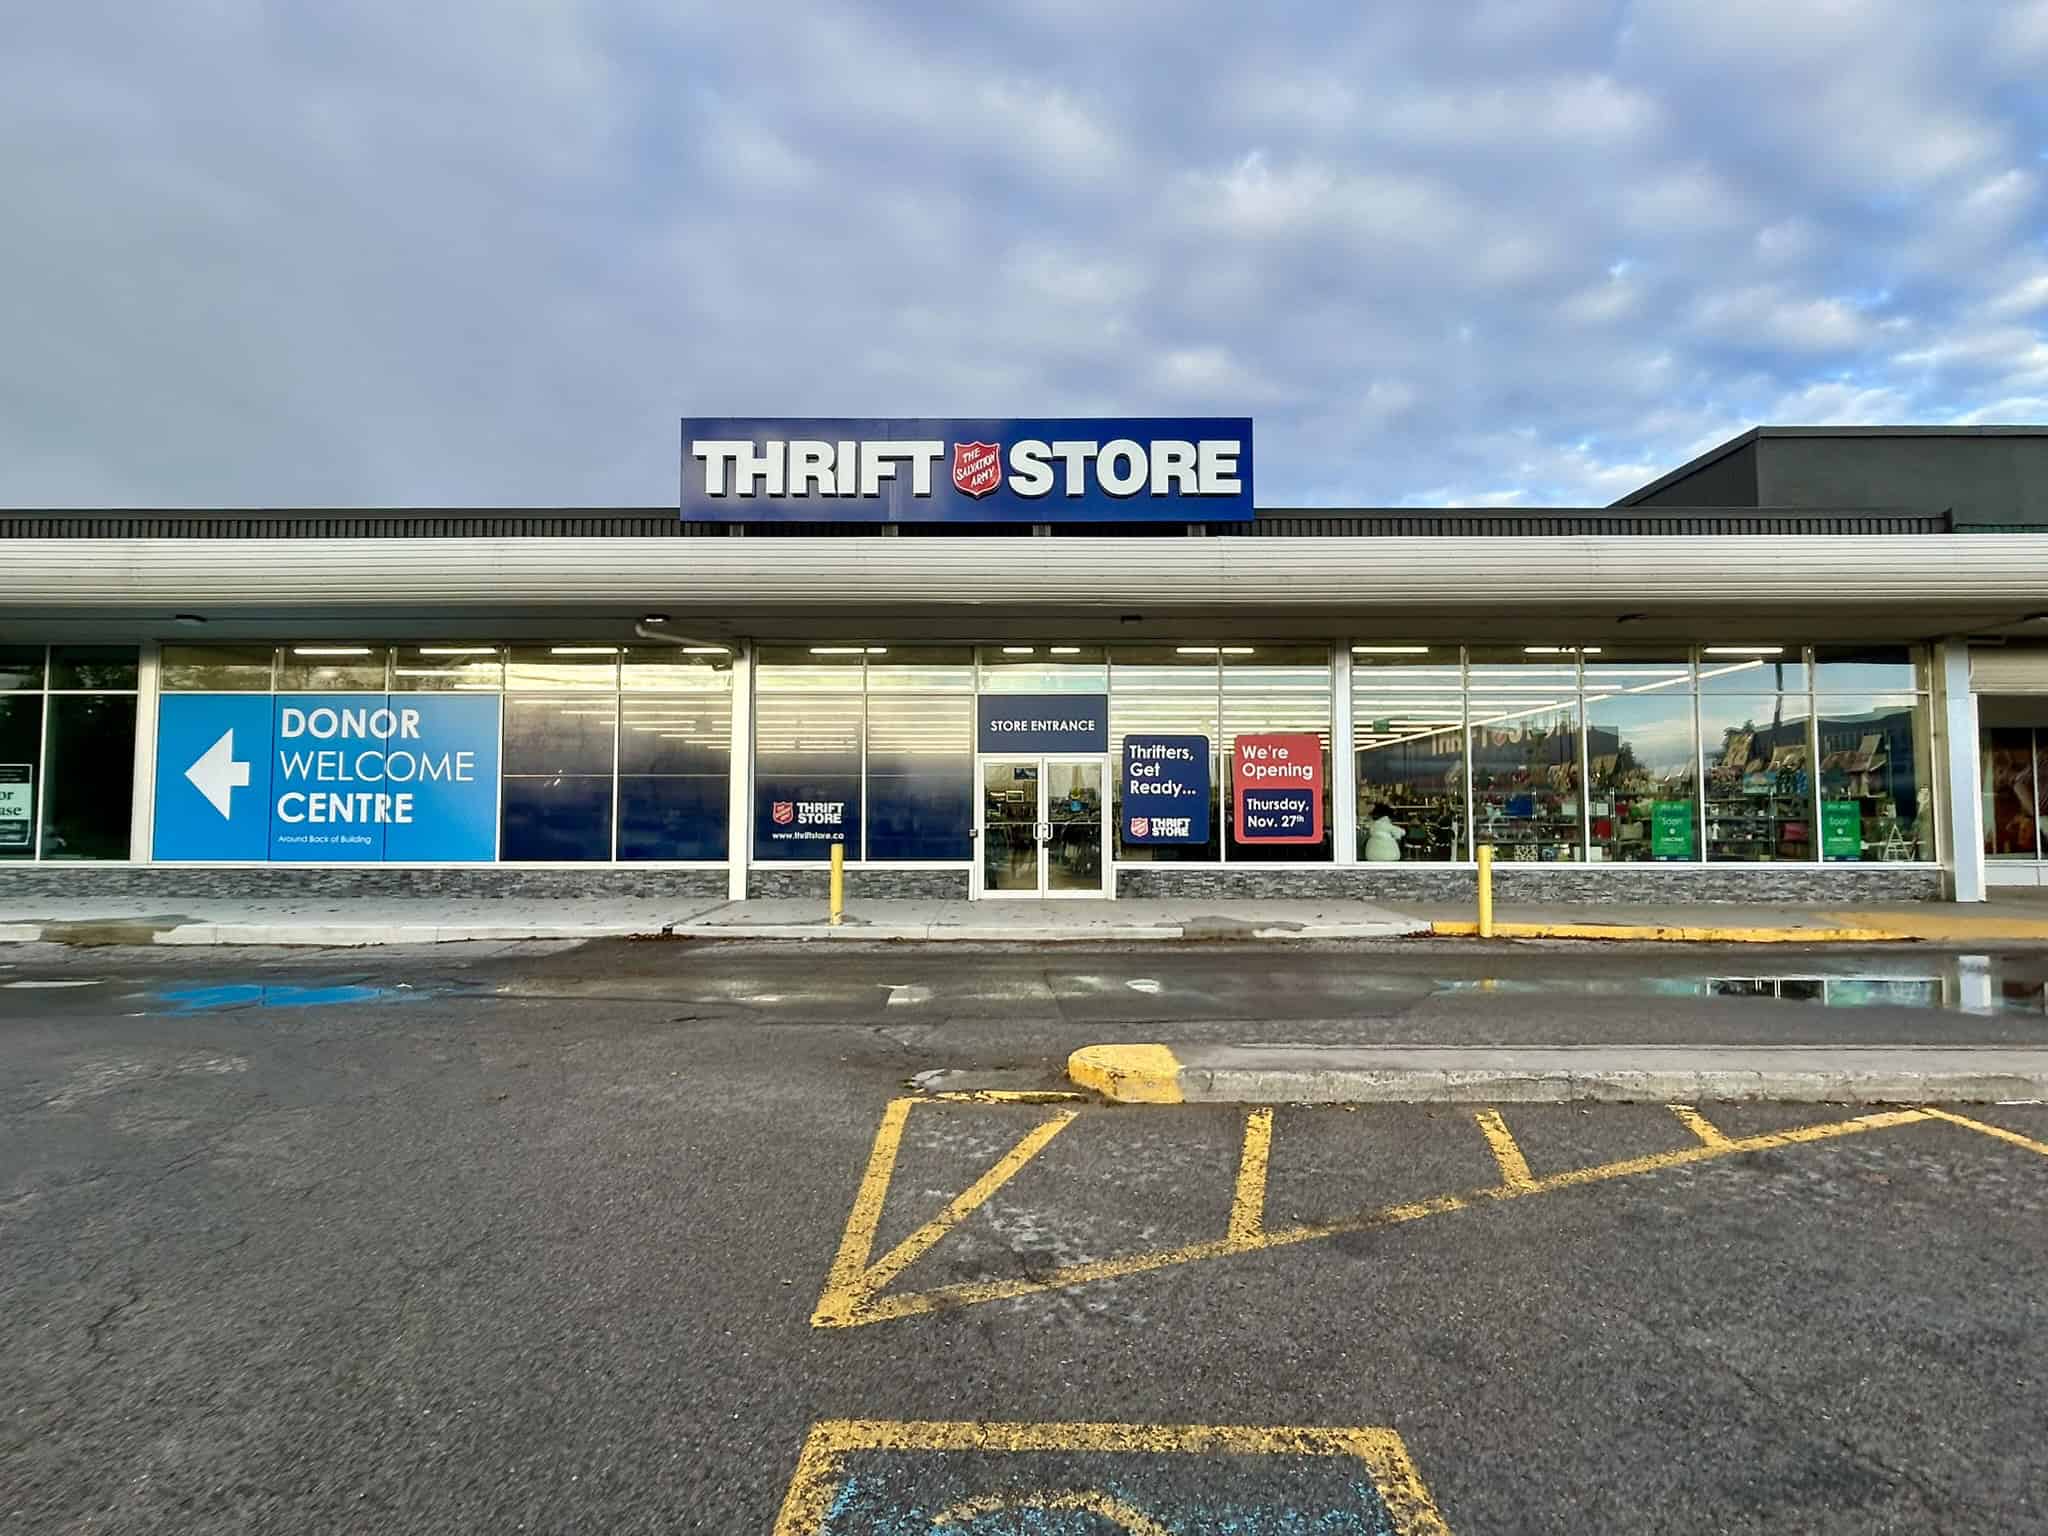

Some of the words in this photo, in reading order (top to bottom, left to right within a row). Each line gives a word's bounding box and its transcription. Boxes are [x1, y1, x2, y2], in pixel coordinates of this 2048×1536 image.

[962, 447, 981, 463] THE
[692, 440, 945, 496] THRIFT
[1008, 439, 1242, 497] STORE
[956, 450, 996, 481] SALVATION
[970, 465, 995, 488] ARMY
[281, 708, 421, 739] DONOR
[990, 720, 1028, 732] STORE
[1031, 720, 1095, 731] ENTRANCE
[1129, 744, 1194, 761] Thrifters,
[1242, 744, 1289, 759] We're
[279, 751, 475, 782] WELCOME
[1130, 762, 1160, 777] Get
[1242, 762, 1313, 780] Opening
[1130, 780, 1197, 798] Ready...
[277, 792, 414, 824] CENTRE
[796, 802, 845, 813] THRIFT
[1246, 798, 1310, 813] Thursday,
[797, 813, 842, 825] STORE
[1150, 818, 1191, 829] THRIFT
[1247, 815, 1278, 828] Nov.
[1281, 815, 1305, 828] 27th
[279, 835, 308, 844] Around
[340, 834, 372, 845] Building
[1151, 828, 1189, 837] STORE
